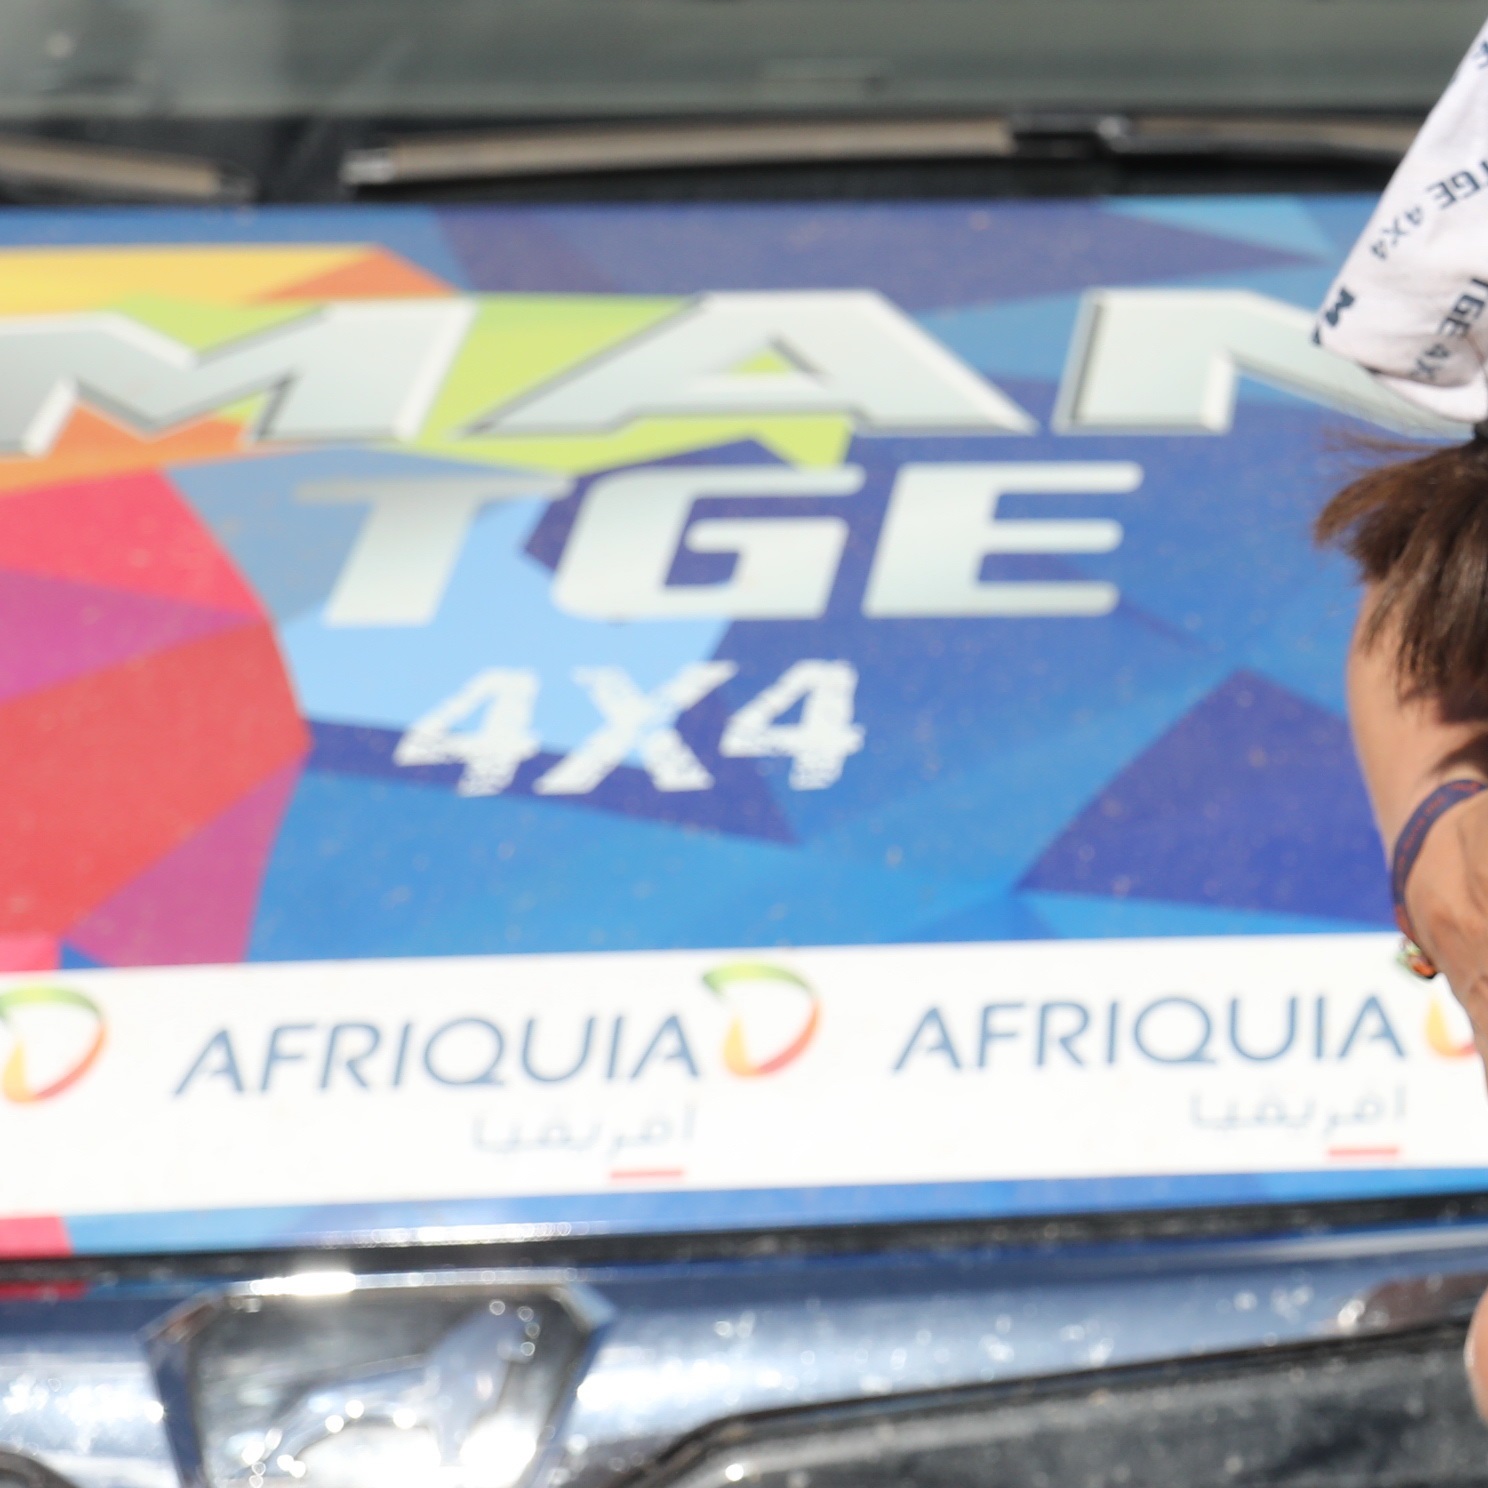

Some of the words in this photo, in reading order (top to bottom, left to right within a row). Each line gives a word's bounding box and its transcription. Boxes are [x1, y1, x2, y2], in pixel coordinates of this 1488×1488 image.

[293, 462, 1142, 627] TGE
[395, 659, 866, 798] 4X4
[172, 1012, 702, 1098] AFRIQUIA
[892, 995, 1408, 1074] AFRIQUIA
